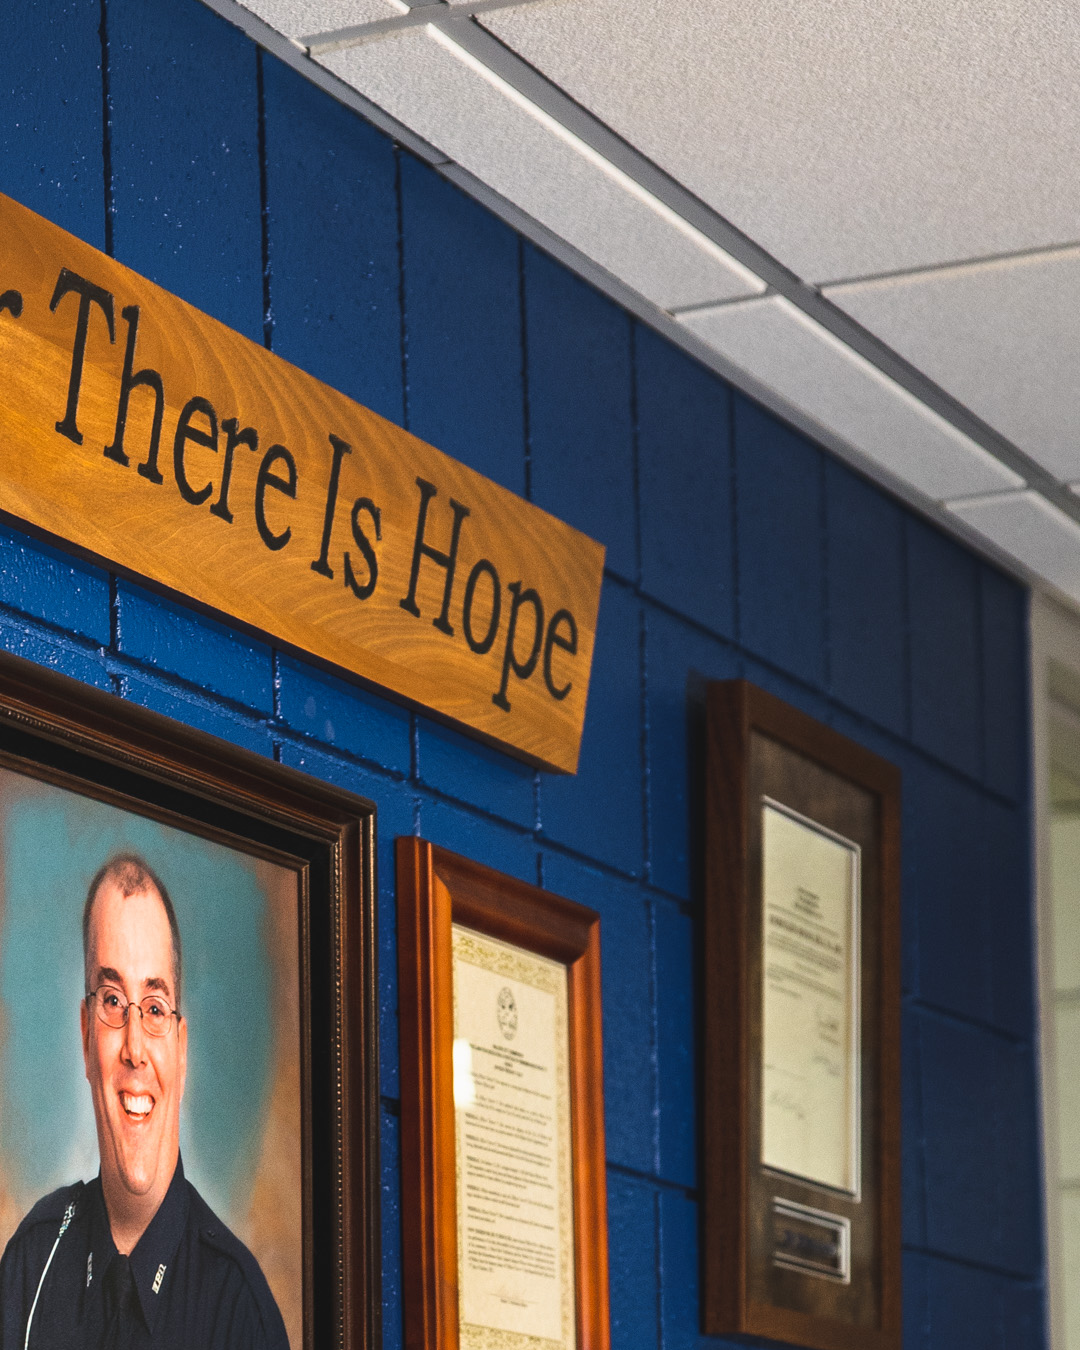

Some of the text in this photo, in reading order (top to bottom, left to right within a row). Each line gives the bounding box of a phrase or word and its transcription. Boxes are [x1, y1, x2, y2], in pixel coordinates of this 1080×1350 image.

[49, 266, 298, 551] There
[310, 433, 382, 600] Is
[399, 476, 578, 712] Hope
